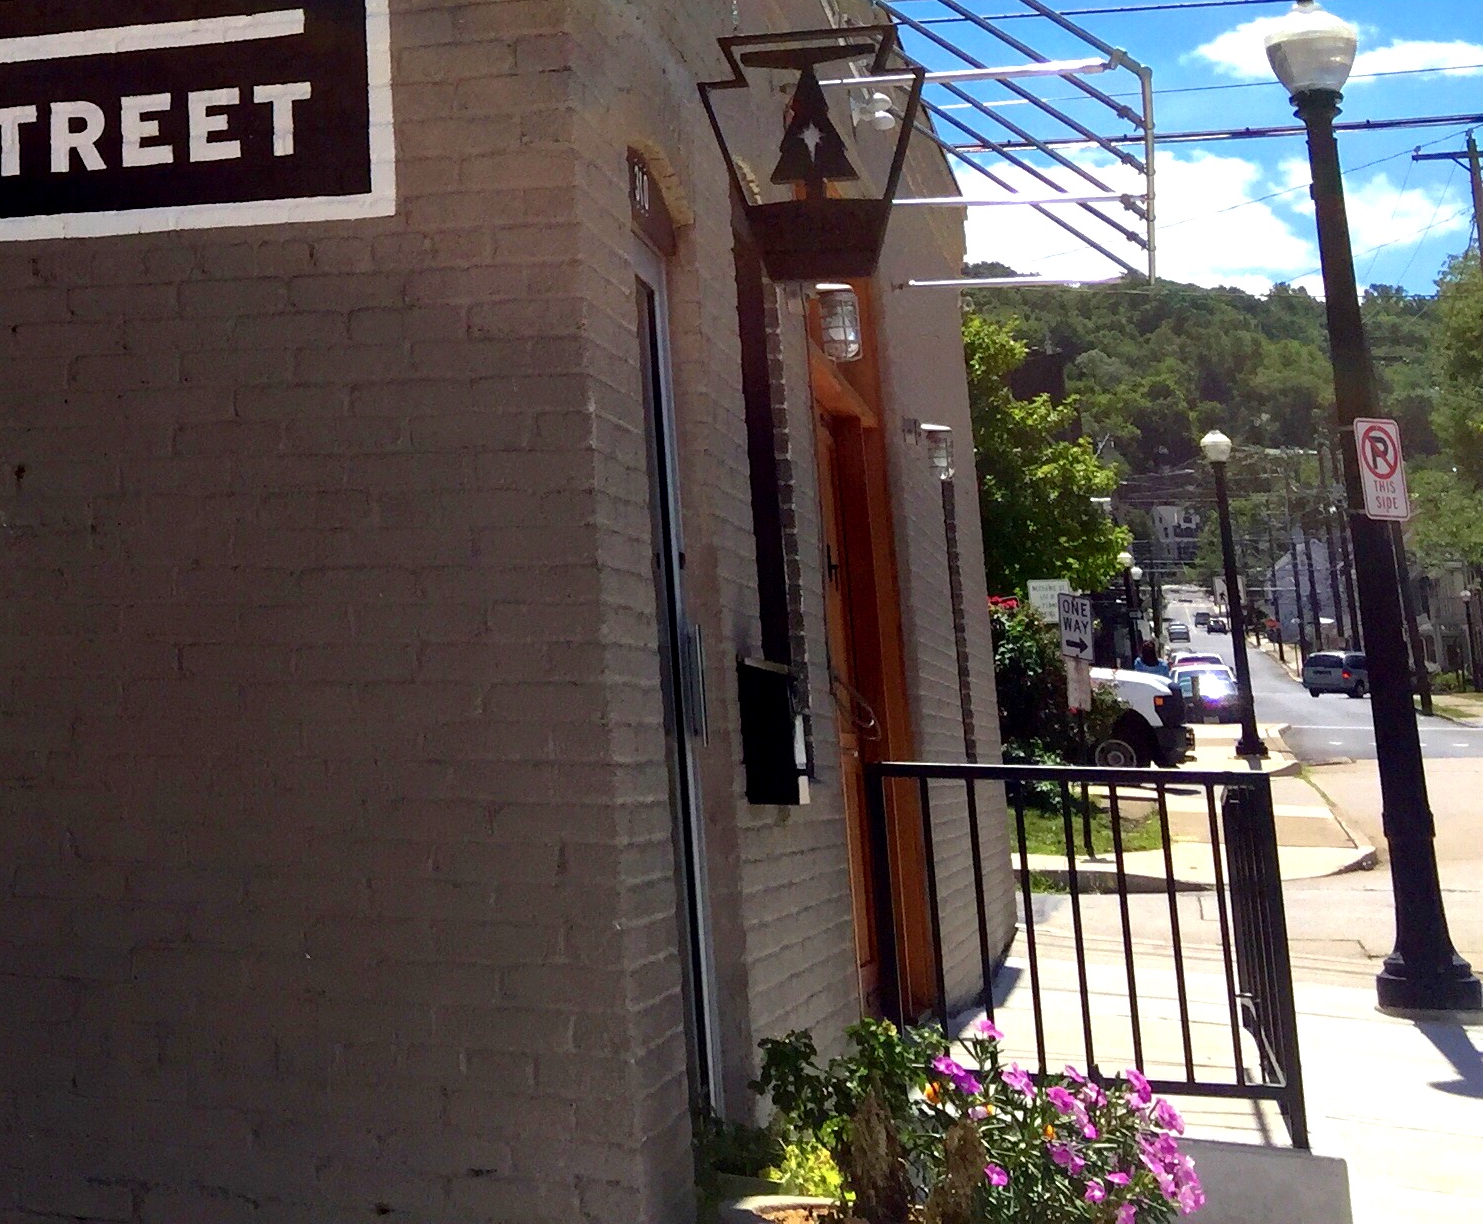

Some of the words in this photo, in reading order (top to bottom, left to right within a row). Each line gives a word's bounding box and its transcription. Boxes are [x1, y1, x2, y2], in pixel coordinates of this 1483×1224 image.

[1373, 479, 1396, 494] THIS
[1375, 496, 1398, 511] SIDE
[1062, 599, 1088, 618] ONE
[1062, 617, 1089, 635] WAY
